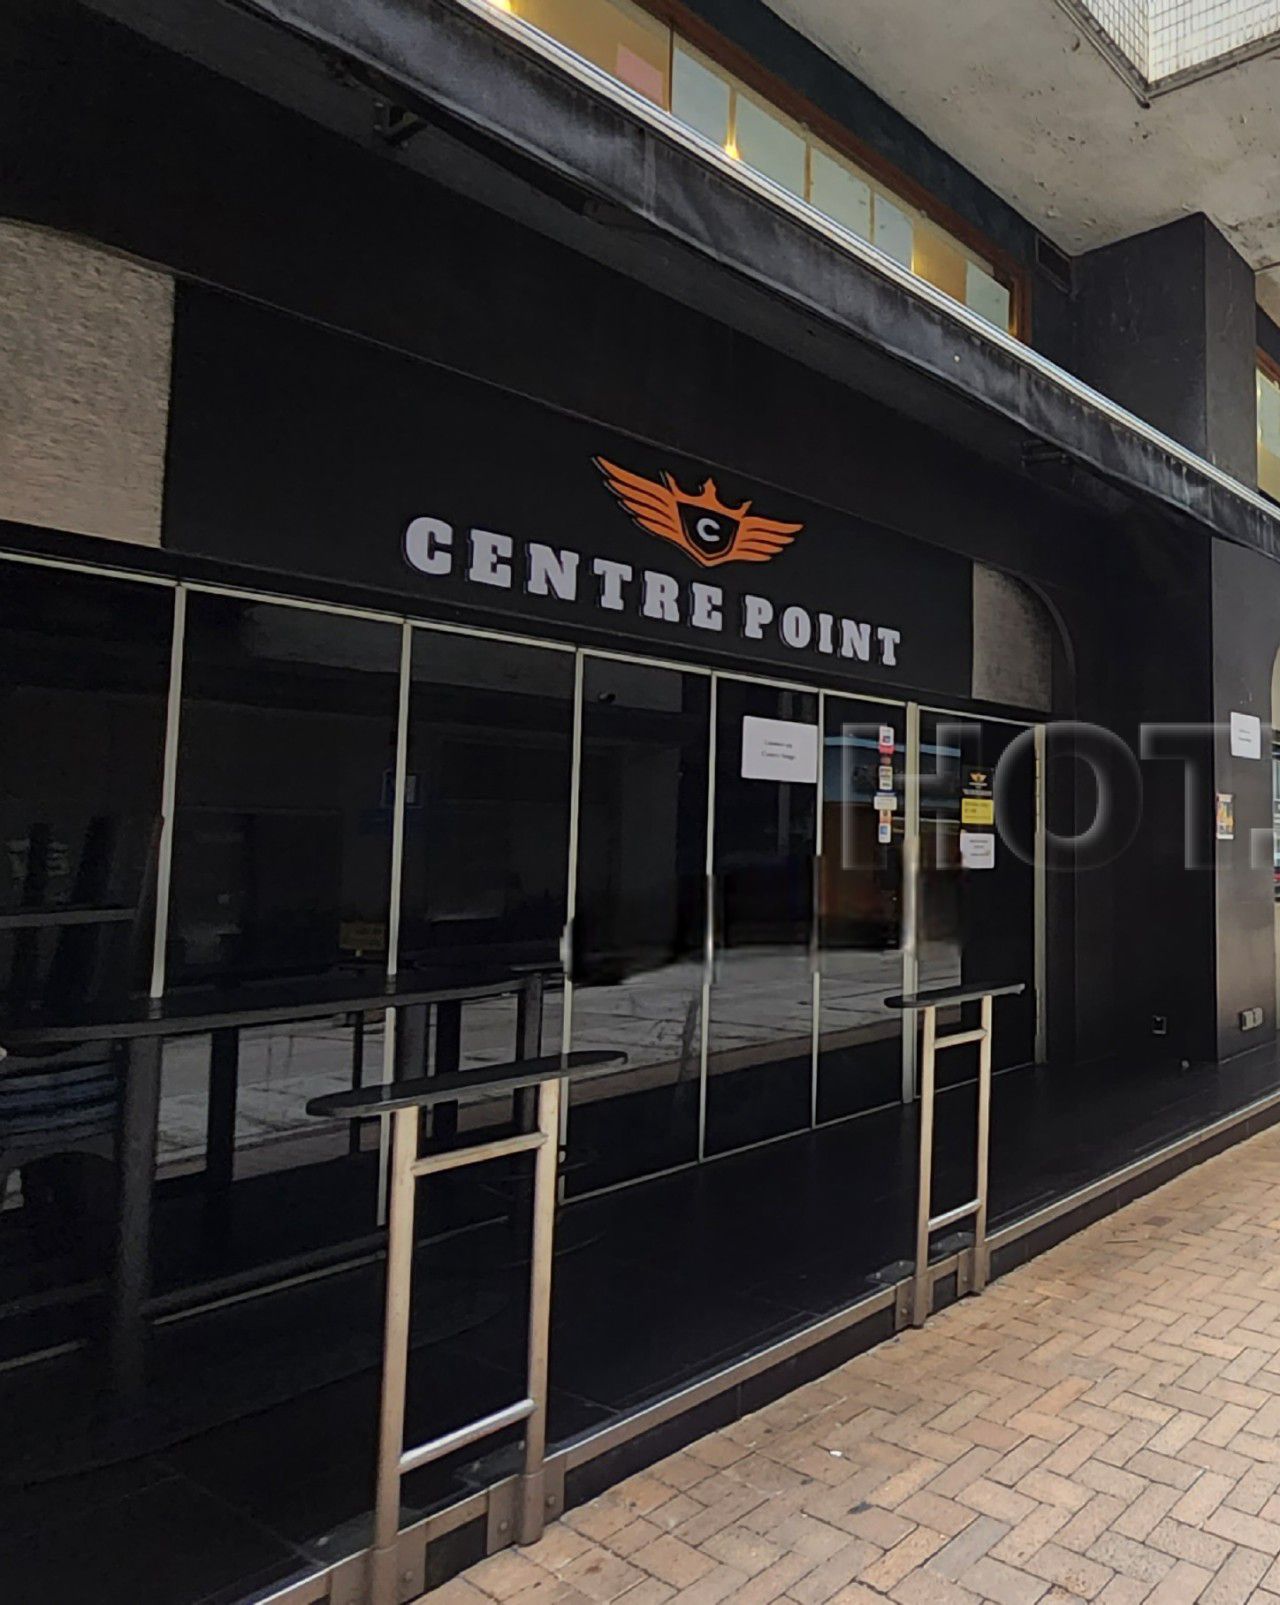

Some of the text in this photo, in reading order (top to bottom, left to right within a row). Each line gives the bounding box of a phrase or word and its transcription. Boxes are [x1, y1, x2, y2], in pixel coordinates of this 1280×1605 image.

[696, 517, 720, 542] C
[404, 516, 900, 666] CENTRE POINT
